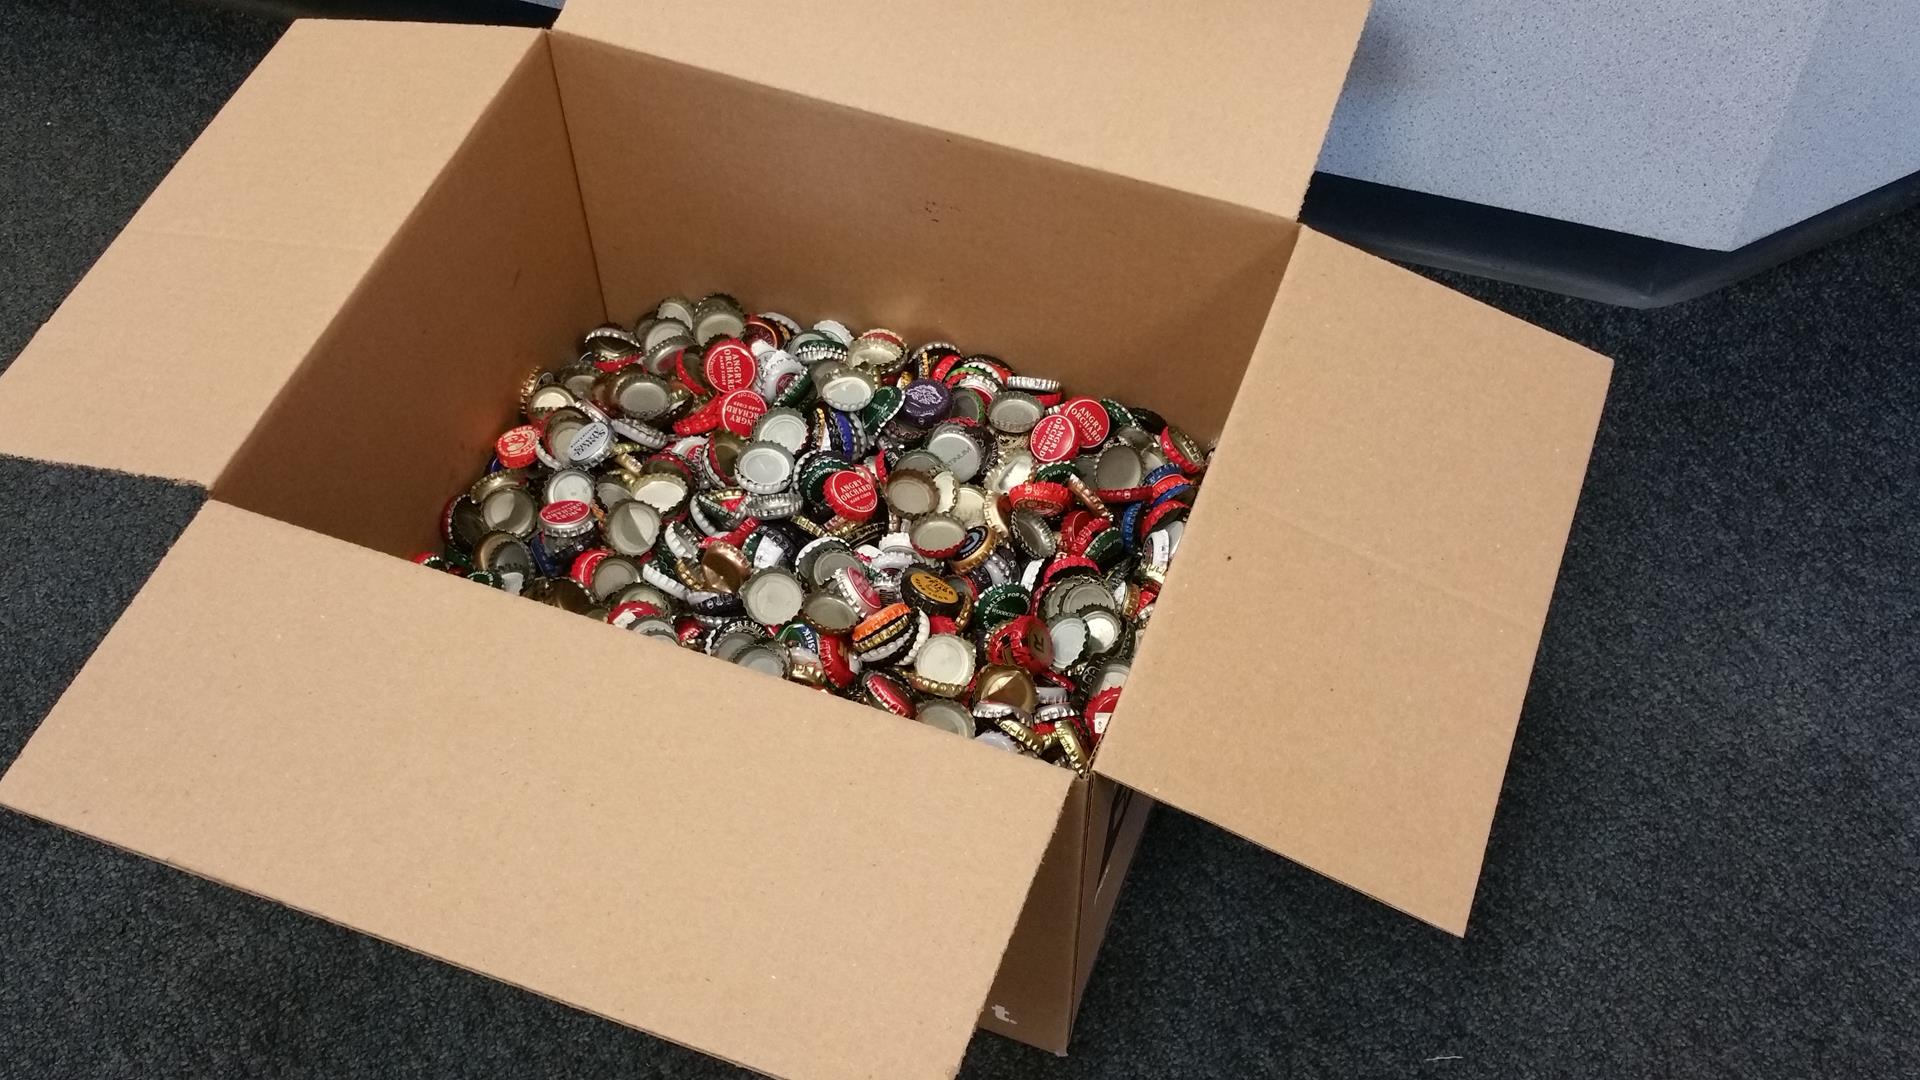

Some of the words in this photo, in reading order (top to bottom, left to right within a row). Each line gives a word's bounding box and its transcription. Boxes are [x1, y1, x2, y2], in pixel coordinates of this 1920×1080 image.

[724, 349, 735, 391] ORCHARD
[733, 354, 742, 384] ANGRY
[727, 405, 759, 420] RCHARD
[730, 415, 753, 426] NGRY
[1079, 407, 1103, 432] ANGRY
[1071, 408, 1101, 442] ORCHARD
[1040, 418, 1063, 457] ORCHARD
[1050, 425, 1066, 454] ANGRY
[840, 479, 862, 493] ANGRY
[840, 484, 872, 502] ORCHARD
[850, 496, 860, 504] HARD
[545, 503, 583, 519] ORCHARD
[984, 595, 1006, 614] SEALED
